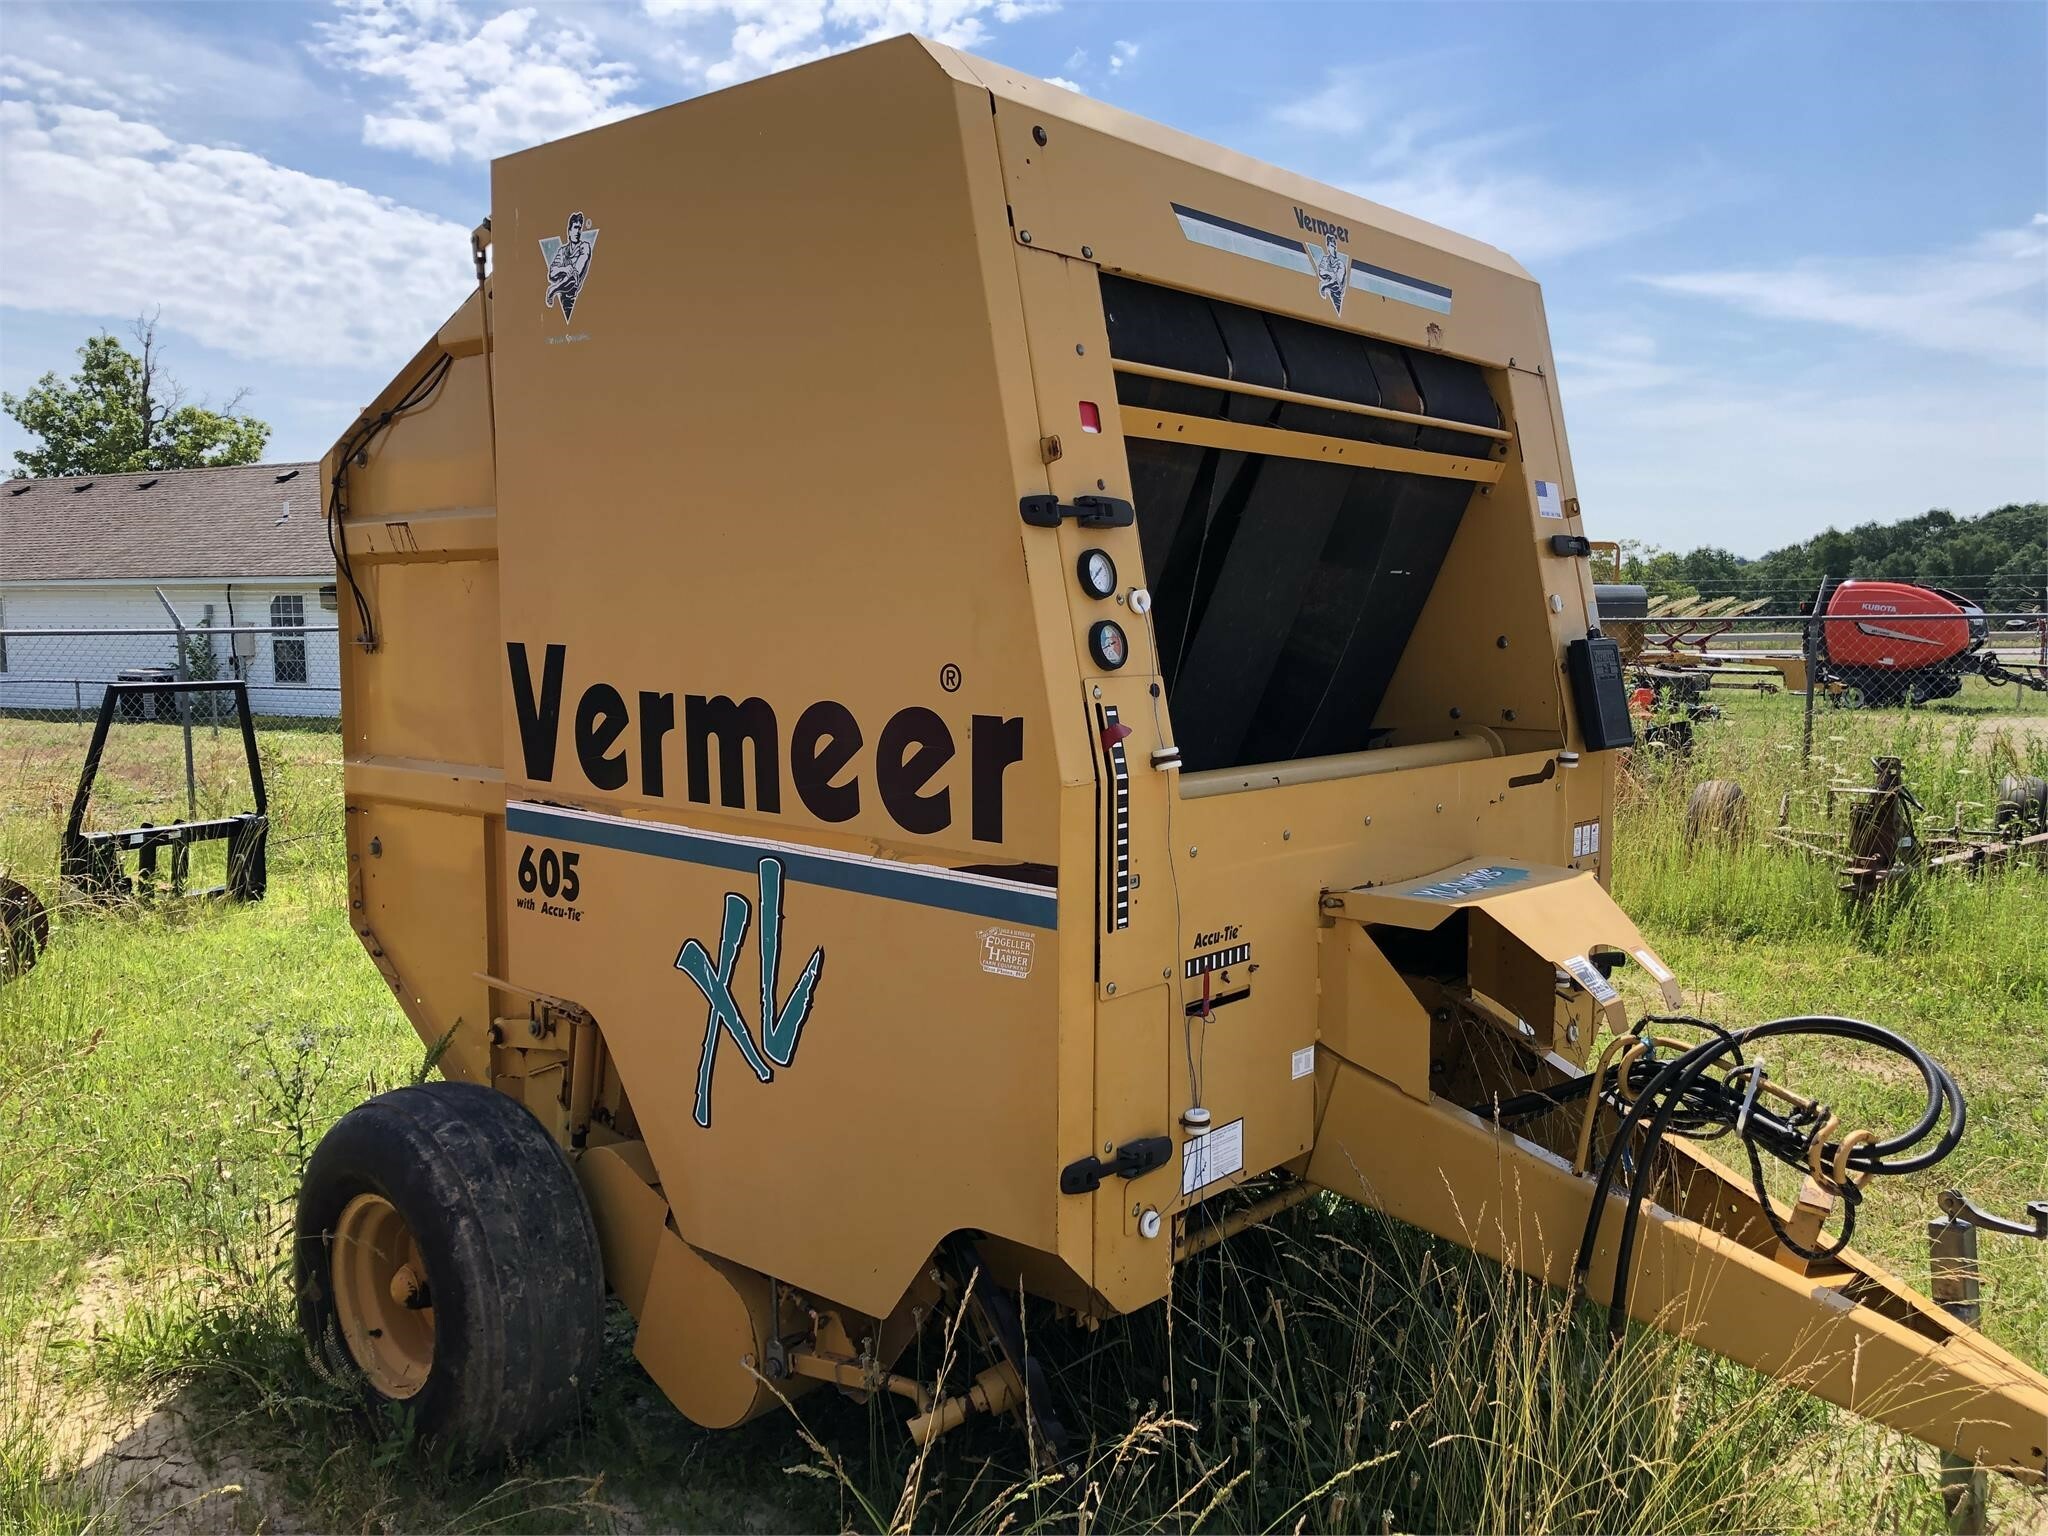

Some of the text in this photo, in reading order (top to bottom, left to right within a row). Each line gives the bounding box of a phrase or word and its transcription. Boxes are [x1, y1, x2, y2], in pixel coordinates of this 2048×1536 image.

[1293, 206, 1349, 243] Vermeer
[1861, 603, 1897, 612] KUBOTA
[506, 642, 1024, 844] Vermeer
[518, 844, 580, 902] 605
[516, 897, 535, 911] with
[985, 935, 1031, 951] EDGELLER
[988, 946, 1028, 966] HARPER
[674, 856, 825, 1128] XL
